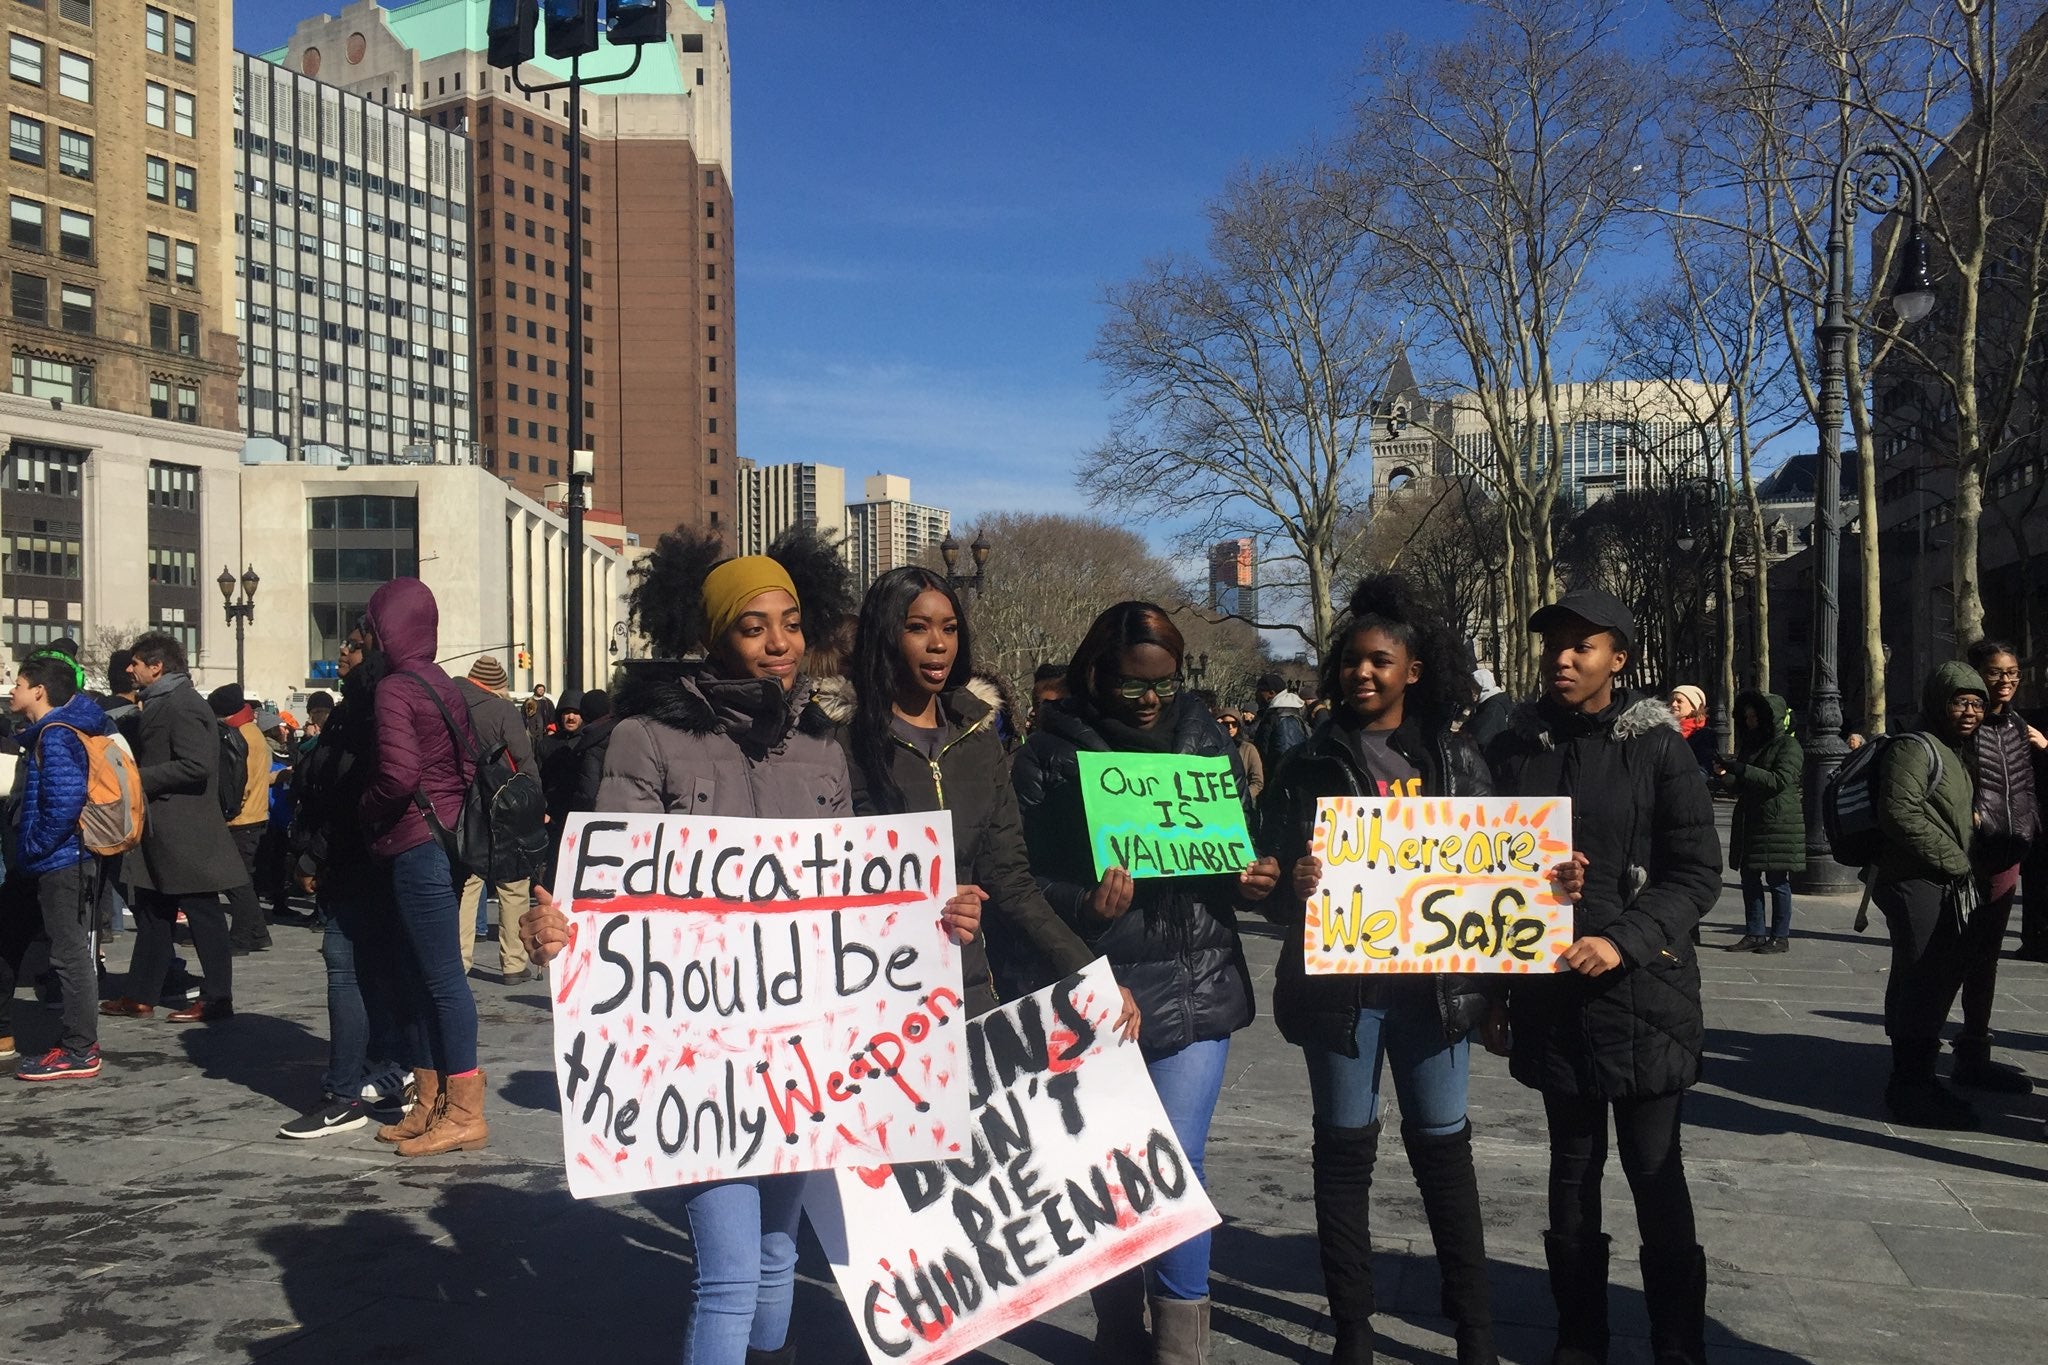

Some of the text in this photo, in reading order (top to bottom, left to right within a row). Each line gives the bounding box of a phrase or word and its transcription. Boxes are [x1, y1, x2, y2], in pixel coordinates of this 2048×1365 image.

[1100, 767, 1238, 803] Our LIFE
[1153, 801, 1203, 828] IS
[591, 909, 922, 1019] Should be
[1321, 884, 1546, 962] We Safe
[564, 1030, 641, 1146] the
[965, 972, 1096, 1111] UNS
